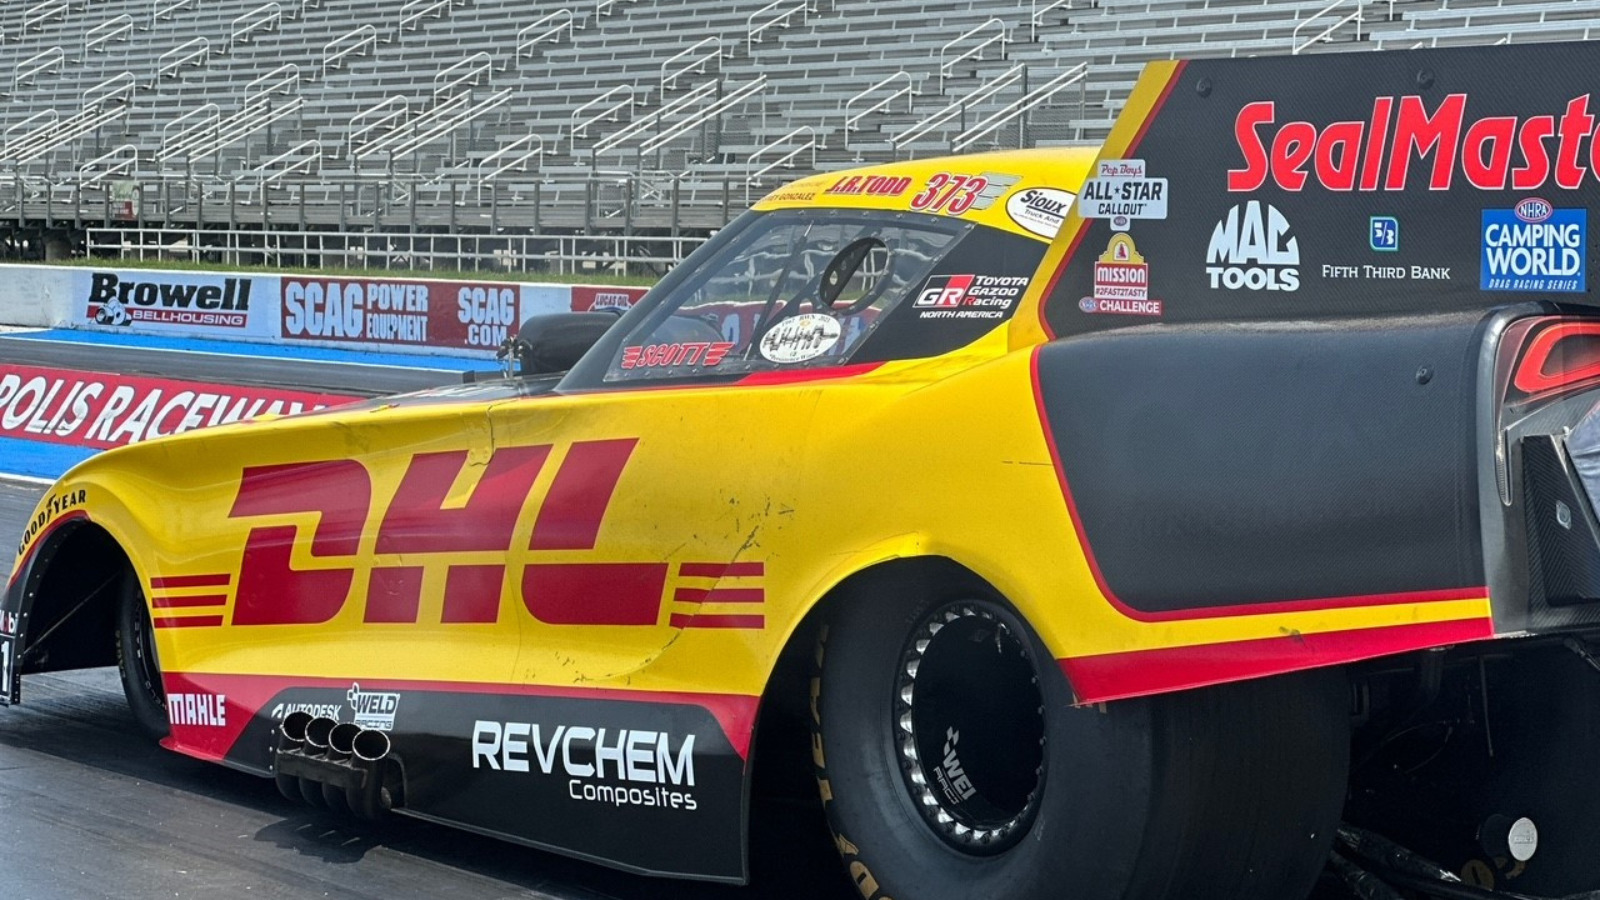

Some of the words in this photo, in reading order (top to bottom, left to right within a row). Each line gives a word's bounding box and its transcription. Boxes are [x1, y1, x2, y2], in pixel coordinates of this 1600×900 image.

[1227, 92, 1600, 192] SealMast
[1101, 164, 1118, 176] Pop
[1120, 164, 1143, 177] Boys
[911, 172, 988, 215] 373
[1020, 190, 1067, 213] Sioux
[1083, 181, 1113, 201] ALL
[1121, 181, 1163, 201] STAR
[1025, 209, 1043, 219] Truck
[1098, 203, 1143, 215] CALLOUT
[1519, 203, 1547, 217] NHRA
[1206, 199, 1300, 265] MAC
[1485, 223, 1580, 248] CAMPING
[1322, 264, 1359, 278] FIFTH
[1363, 264, 1406, 280] THIRD
[1411, 265, 1451, 280] BANK
[1485, 247, 1580, 276] WORLD
[975, 275, 1030, 286] TOYOTA
[1097, 266, 1146, 283] MISSION
[1206, 266, 1300, 291] TOOLS
[1489, 278, 1511, 289] DRAG
[1513, 279, 1545, 289] RACING
[1547, 280, 1578, 290] SERIES
[88, 272, 252, 311] Browell
[366, 283, 429, 312] POWER
[917, 288, 965, 305] GR
[968, 286, 1020, 296] GAZOO
[1096, 287, 1147, 297] #2FAST2TASTY
[285, 281, 364, 338] SCAG
[458, 286, 515, 326] SCAG
[920, 310, 955, 319] NORTH
[955, 310, 1004, 319] AMERICA
[962, 296, 1013, 310] Racing
[1100, 300, 1160, 313] CHALLENGE
[133, 310, 244, 326] BELLHOUSING
[366, 313, 428, 342] EQUIPMENT
[636, 342, 710, 367] SCOTT
[0, 374, 104, 437] POLIS
[84, 385, 326, 444] RACE
[18, 489, 86, 556] GOODYEAR
[228, 437, 669, 626] DHL
[167, 693, 226, 726] MAHLE
[284, 703, 342, 720] AUTODESK
[356, 694, 397, 714] WELD
[472, 719, 696, 786] REVCHEM
[569, 779, 698, 810] Composites
